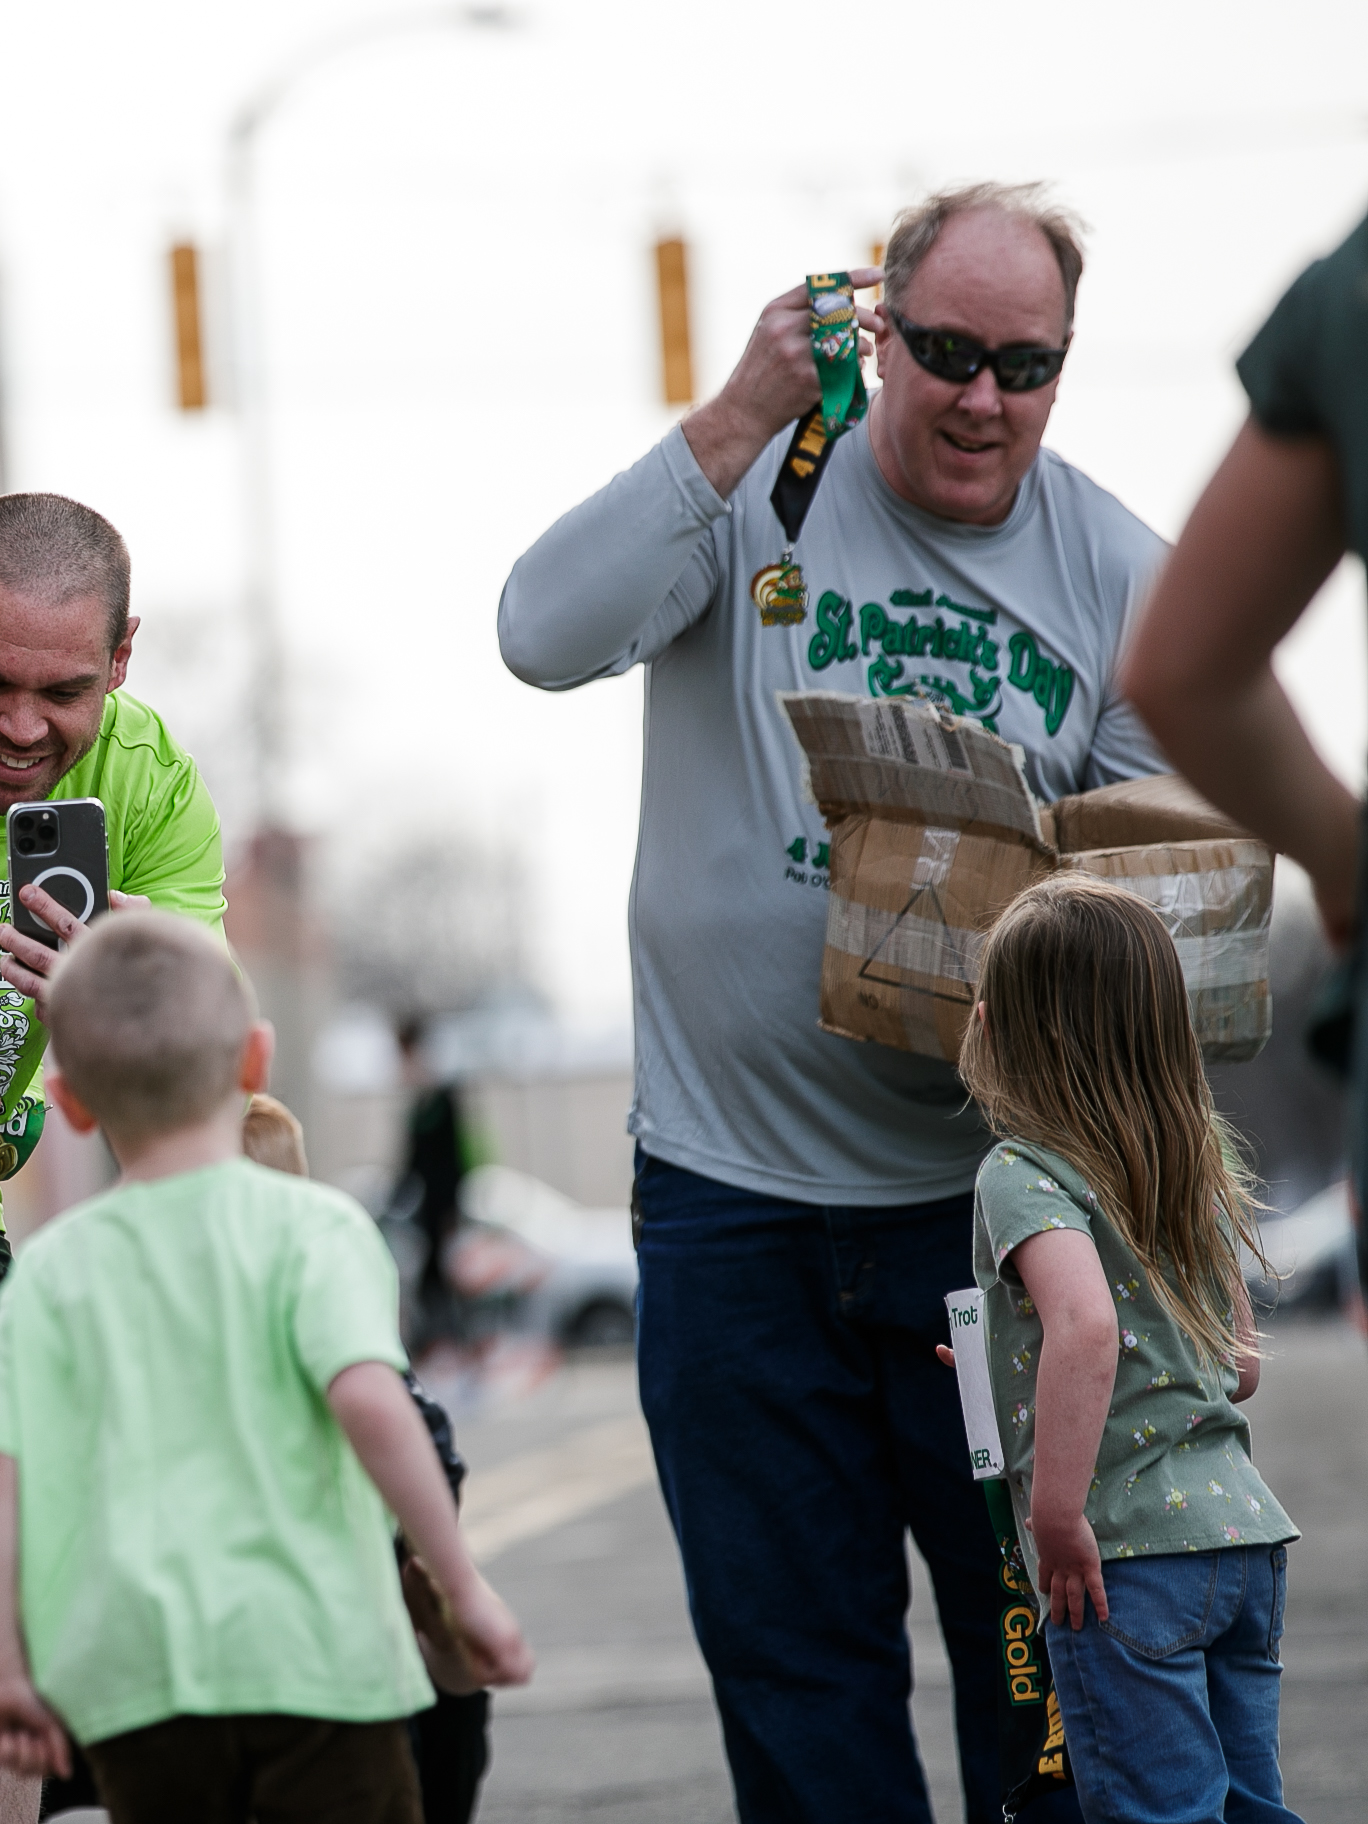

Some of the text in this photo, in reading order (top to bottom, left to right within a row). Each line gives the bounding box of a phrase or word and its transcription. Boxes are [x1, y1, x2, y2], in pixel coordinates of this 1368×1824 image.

[790, 456, 816, 480] 4
[807, 589, 1075, 737] St. Patrick's Day
[810, 873, 831, 892] O'C
[952, 1305, 978, 1329] Trot
[970, 1448, 993, 1470] NER
[1003, 1605, 1041, 1702] Gold
